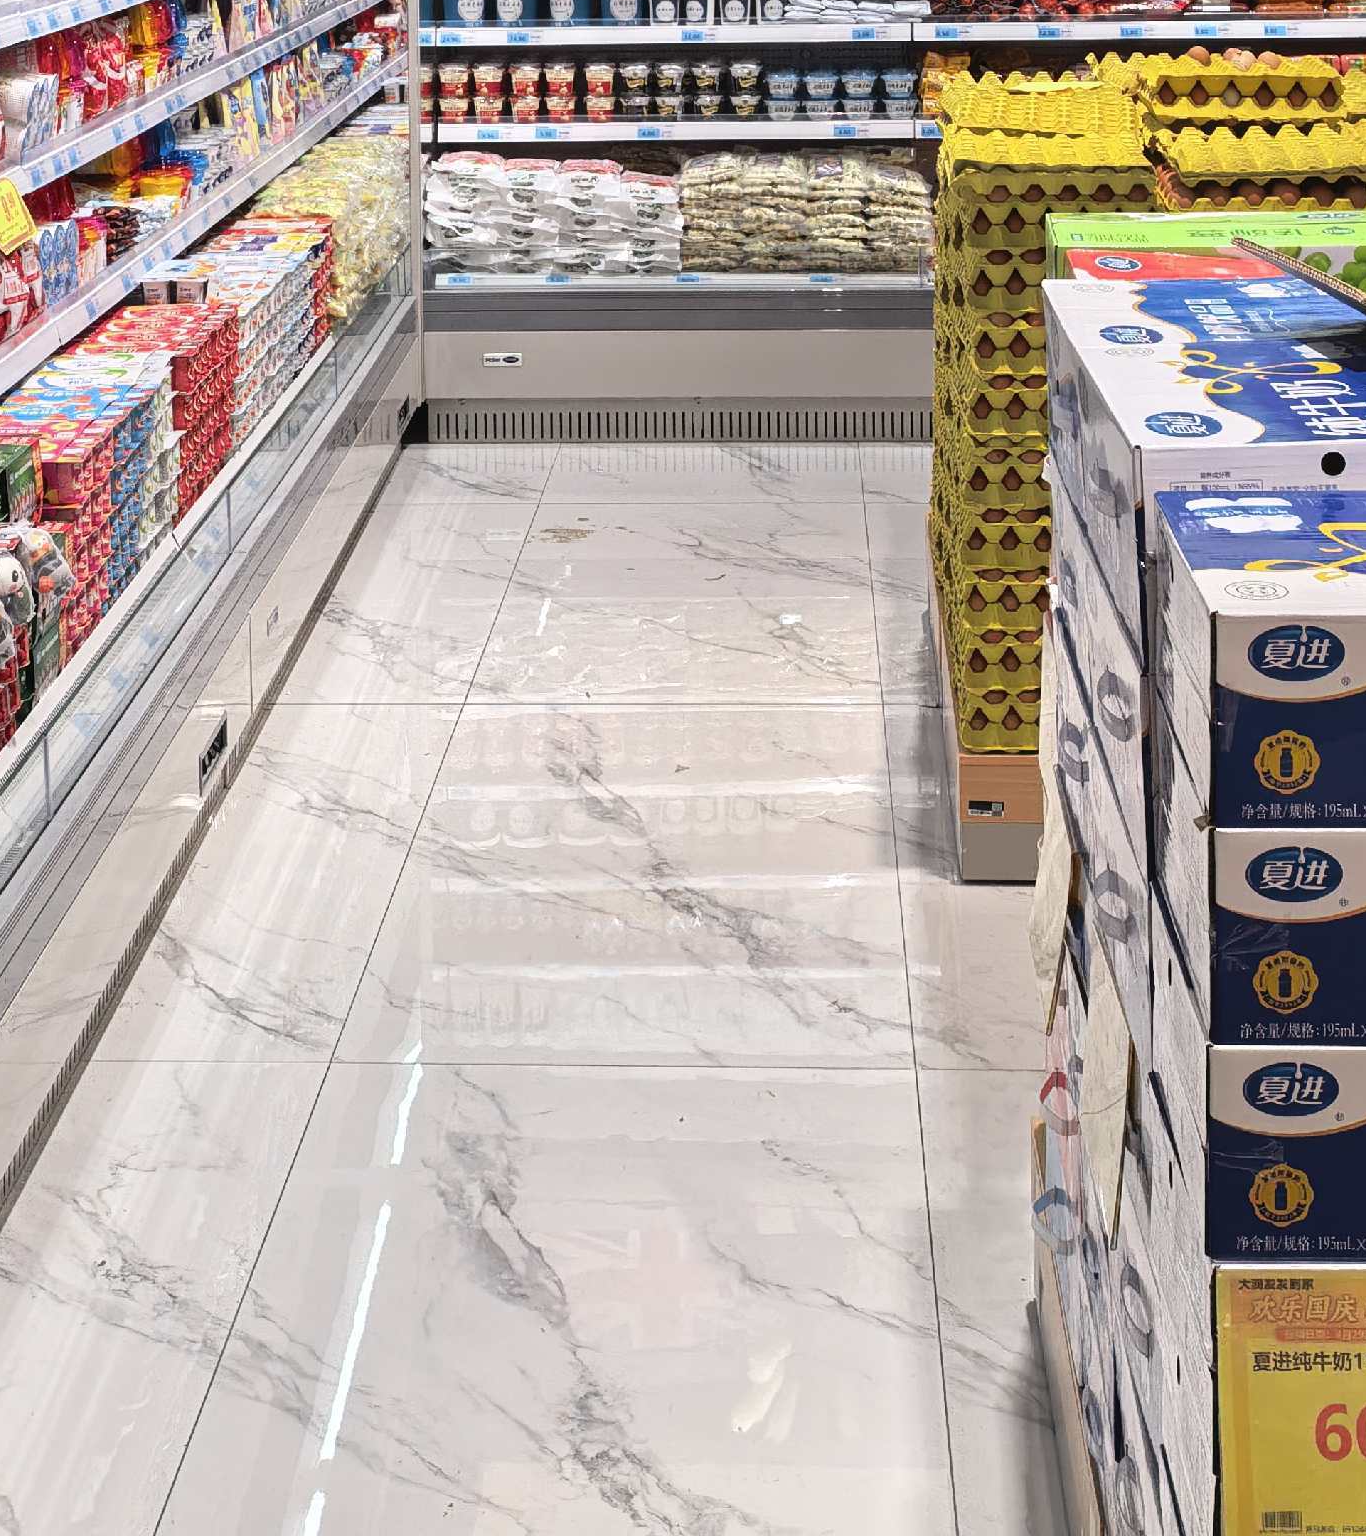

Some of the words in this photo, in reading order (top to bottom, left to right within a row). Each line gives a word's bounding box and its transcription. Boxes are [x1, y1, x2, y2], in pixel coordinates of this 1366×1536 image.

[1262, 625, 1332, 670] 夏进
[1260, 849, 1330, 893] 夏进
[1255, 1064, 1326, 1107] 夏进
[1248, 1294, 1359, 1324] 欢乐国庆
